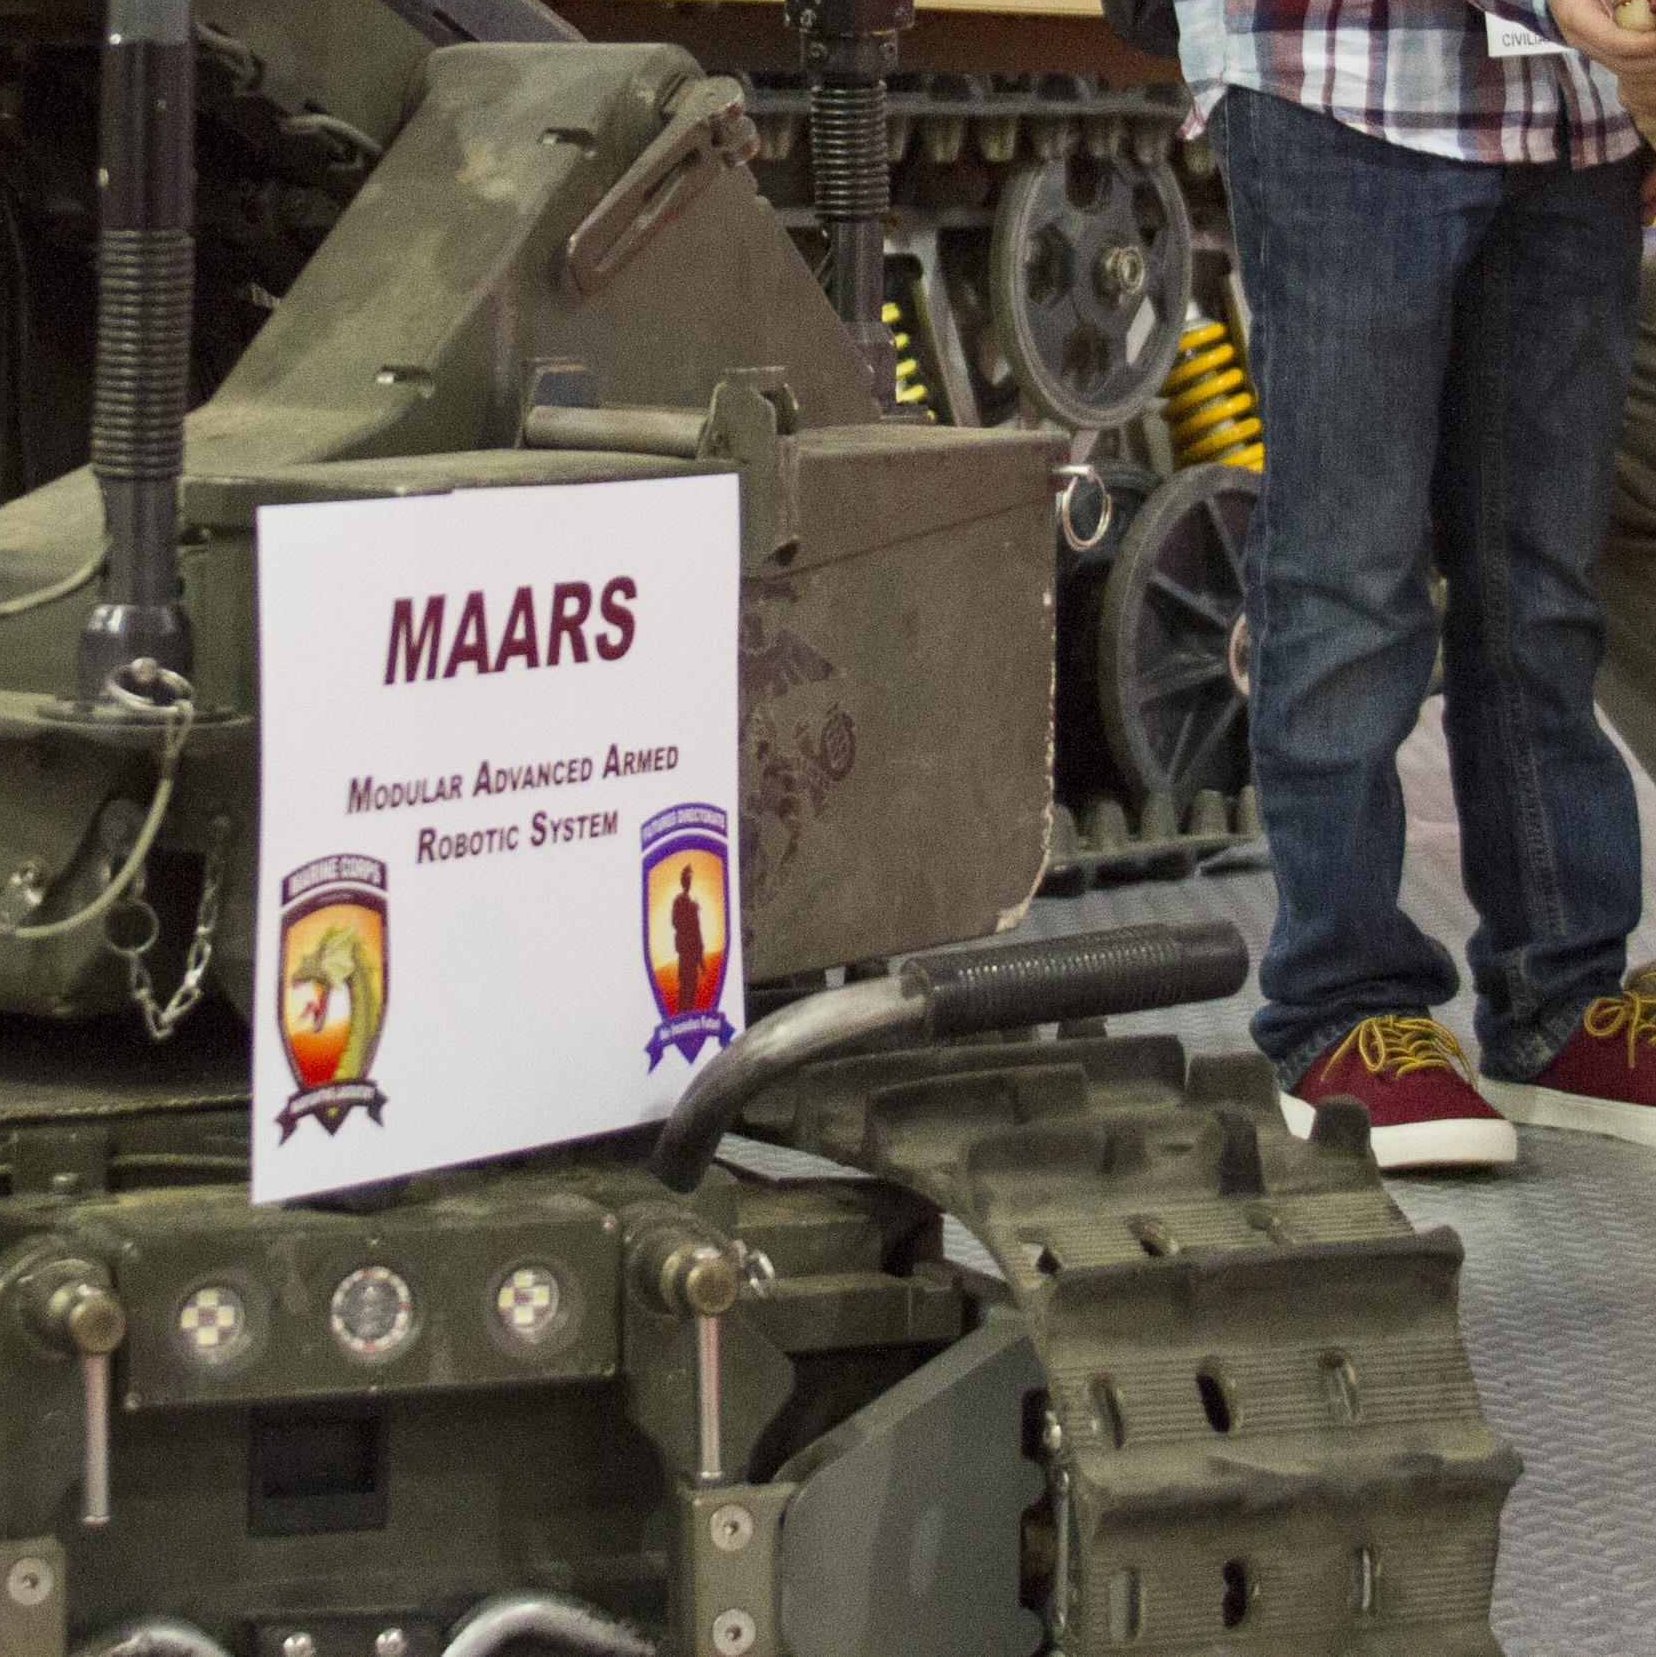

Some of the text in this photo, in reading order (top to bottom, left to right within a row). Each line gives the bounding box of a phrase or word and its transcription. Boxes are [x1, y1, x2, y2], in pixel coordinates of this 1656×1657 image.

[384, 574, 638, 687] MAARS
[345, 743, 680, 815] MODULAR ADVANCED ARMED
[416, 826, 520, 865] ROBOTIC
[530, 809, 619, 848] SYSTEM
